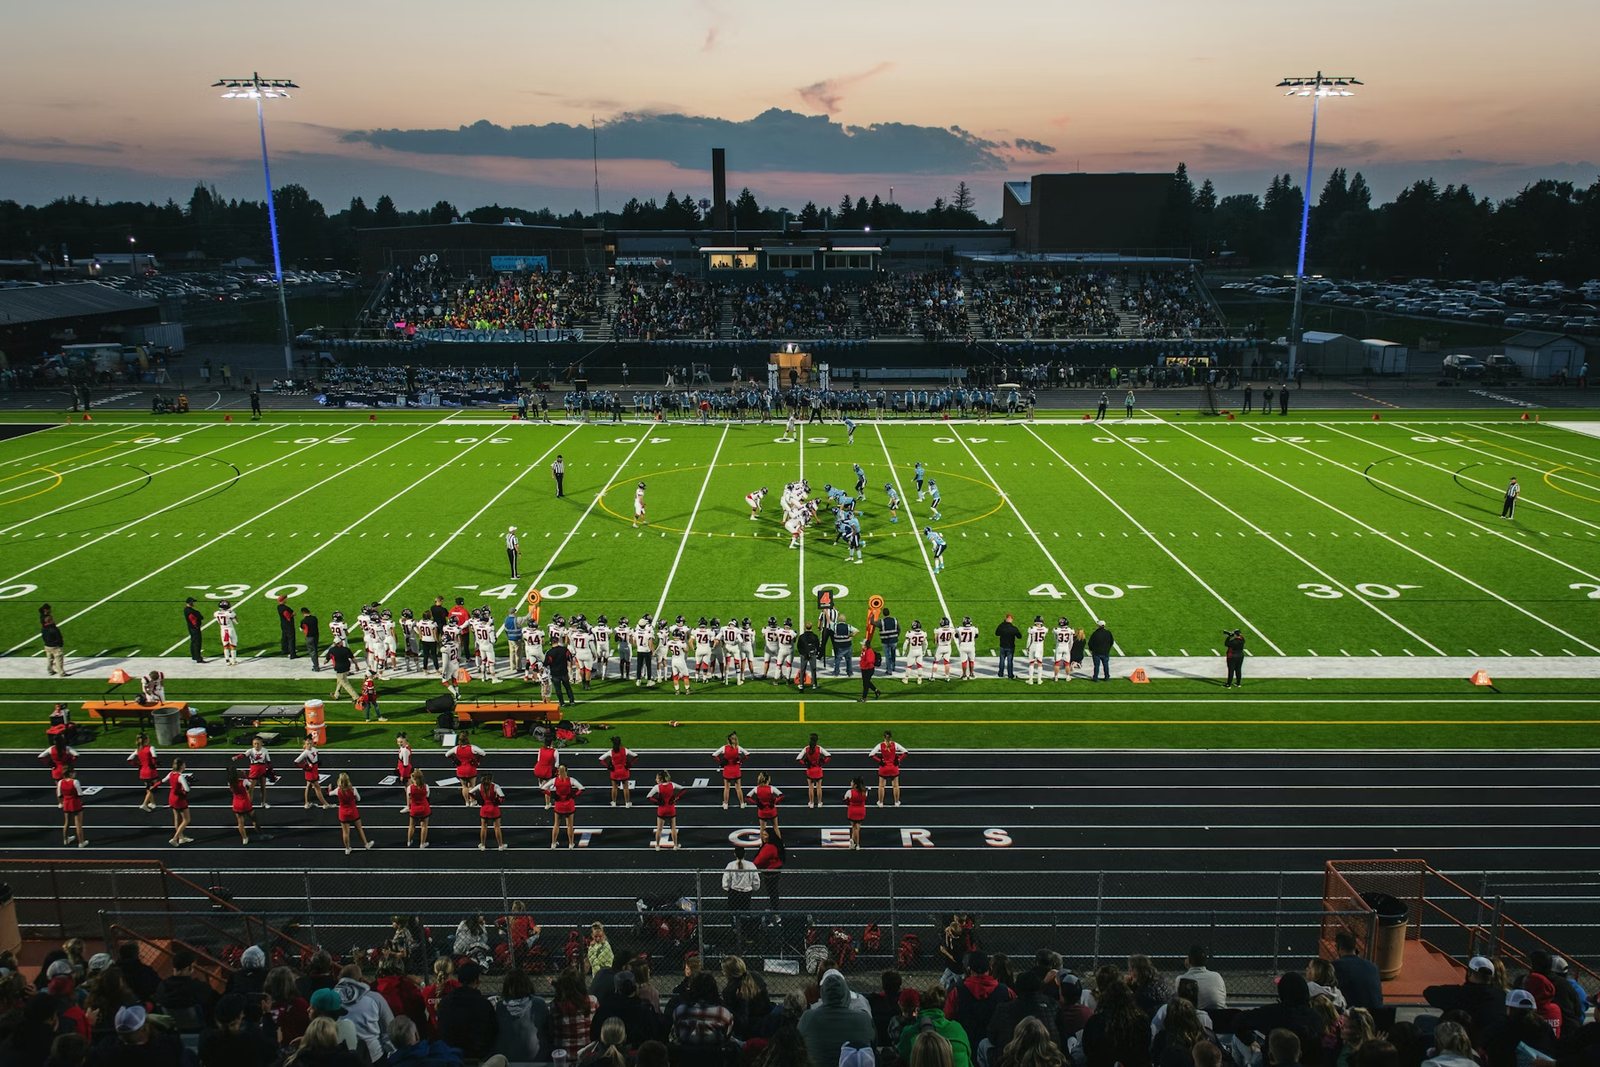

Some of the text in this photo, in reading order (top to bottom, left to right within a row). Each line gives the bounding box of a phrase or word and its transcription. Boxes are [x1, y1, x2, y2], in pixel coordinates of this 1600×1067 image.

[205, 584, 308, 599] 30
[479, 584, 578, 599] 40
[754, 584, 849, 599] 50
[1028, 583, 1124, 599] 40
[1297, 583, 1400, 599] 30
[819, 592, 831, 604] 4
[476, 629, 488, 640] 50
[596, 632, 606, 642] 19
[697, 634, 709, 644] 74
[724, 631, 735, 642] 10
[779, 634, 792, 645] 79
[939, 632, 952, 642] 40
[961, 632, 973, 642] 71
[1034, 631, 1045, 642] 15
[1057, 632, 1070, 643] 33
[527, 635, 542, 646] 44
[574, 638, 585, 649] 77
[638, 636, 644, 646] 7
[912, 636, 924, 647] 35
[668, 645, 680, 656] 56
[573, 828, 1013, 848] TIGERS
